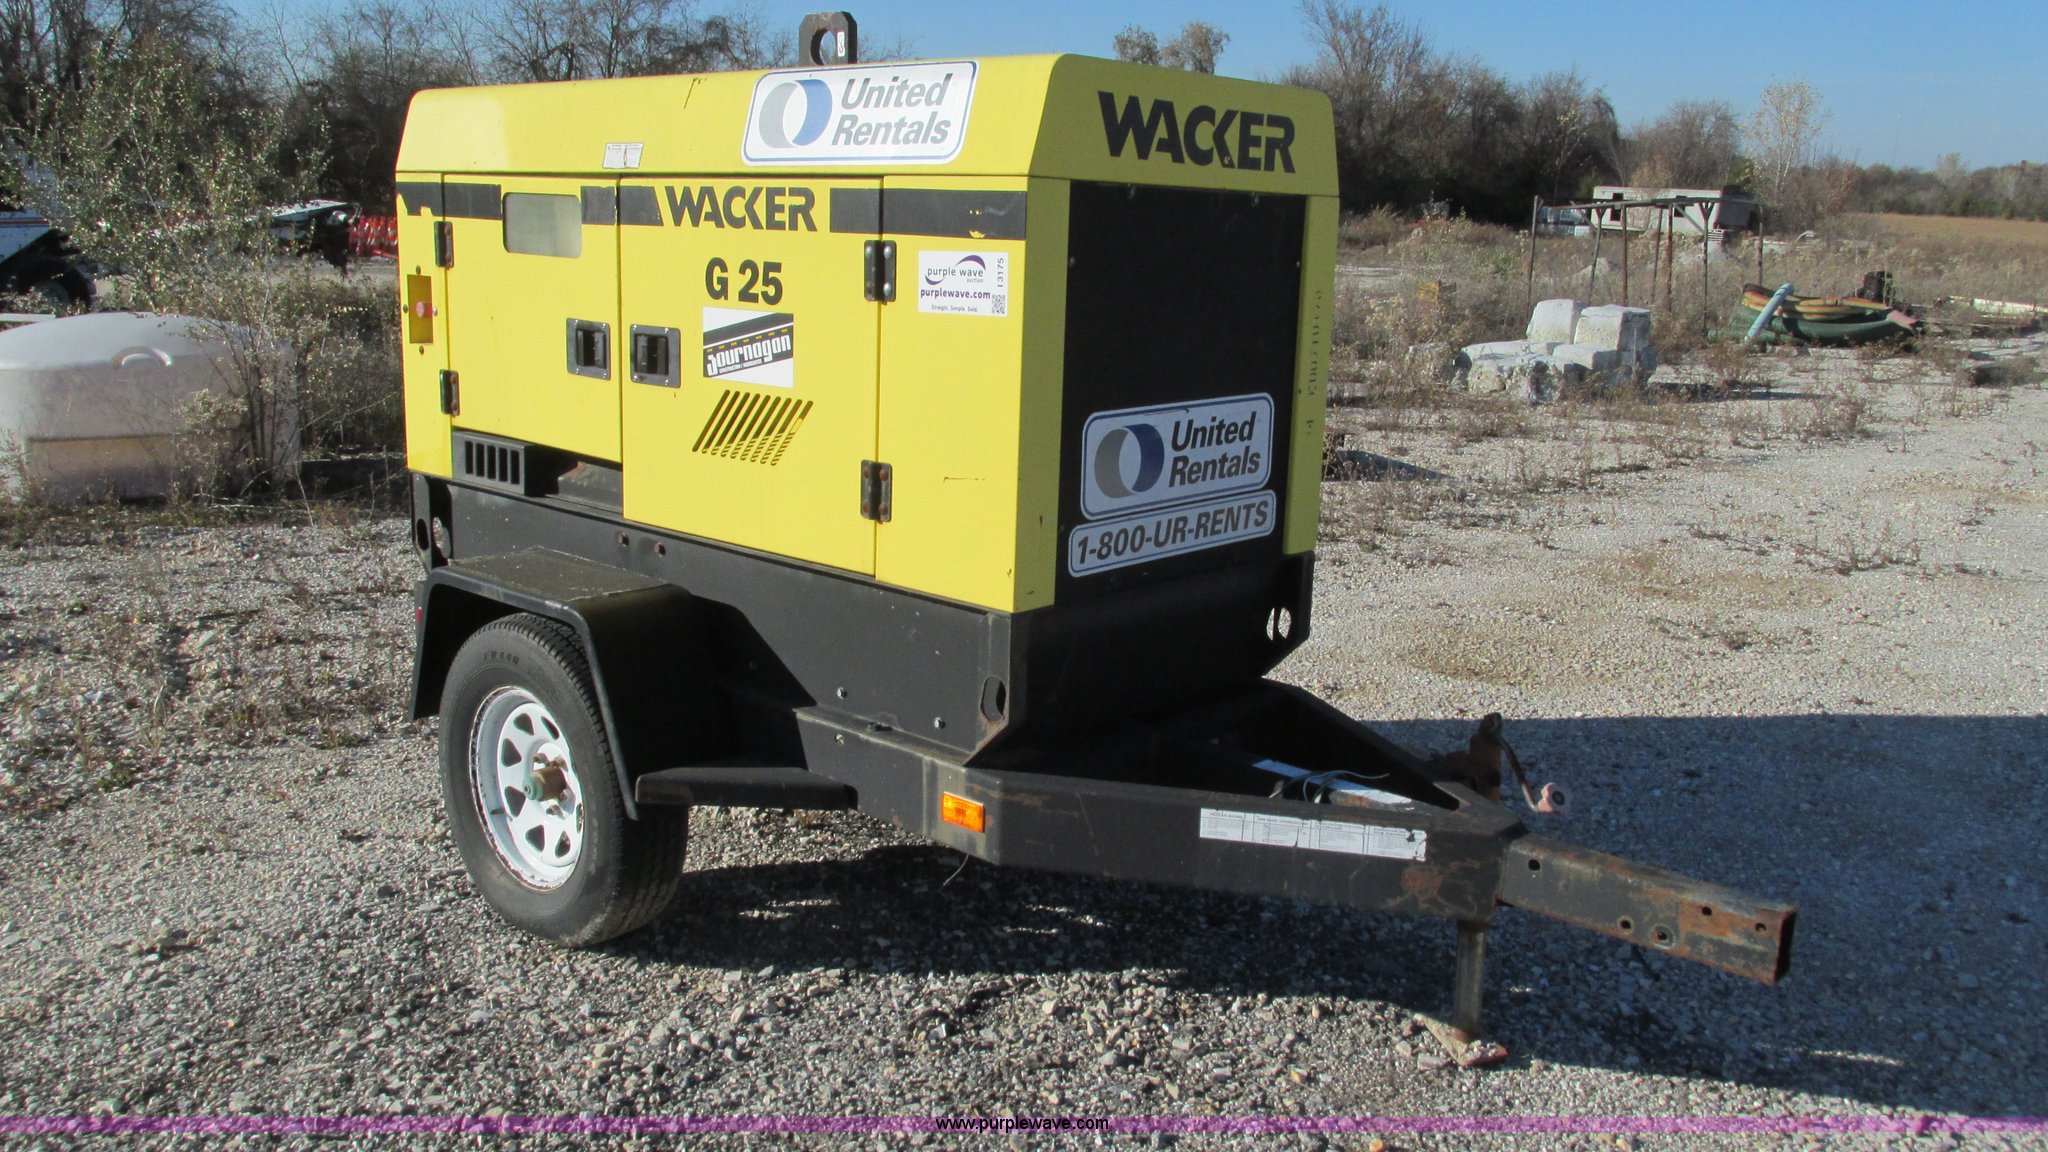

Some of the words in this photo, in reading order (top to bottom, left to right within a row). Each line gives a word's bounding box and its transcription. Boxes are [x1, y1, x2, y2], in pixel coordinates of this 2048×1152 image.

[841, 73, 954, 110] United
[831, 111, 952, 146] Rentals
[1097, 90, 1296, 174] WACKER
[664, 186, 818, 232] WACKER
[705, 257, 729, 301] G
[738, 259, 783, 305] 25
[920, 287, 991, 300] purplewave.com
[927, 267, 957, 277] purple
[959, 269, 984, 278] wave
[1171, 411, 1257, 452] United
[1168, 445, 1261, 488] Rentals
[1077, 500, 1269, 565] 1-800-UR-RENTS
